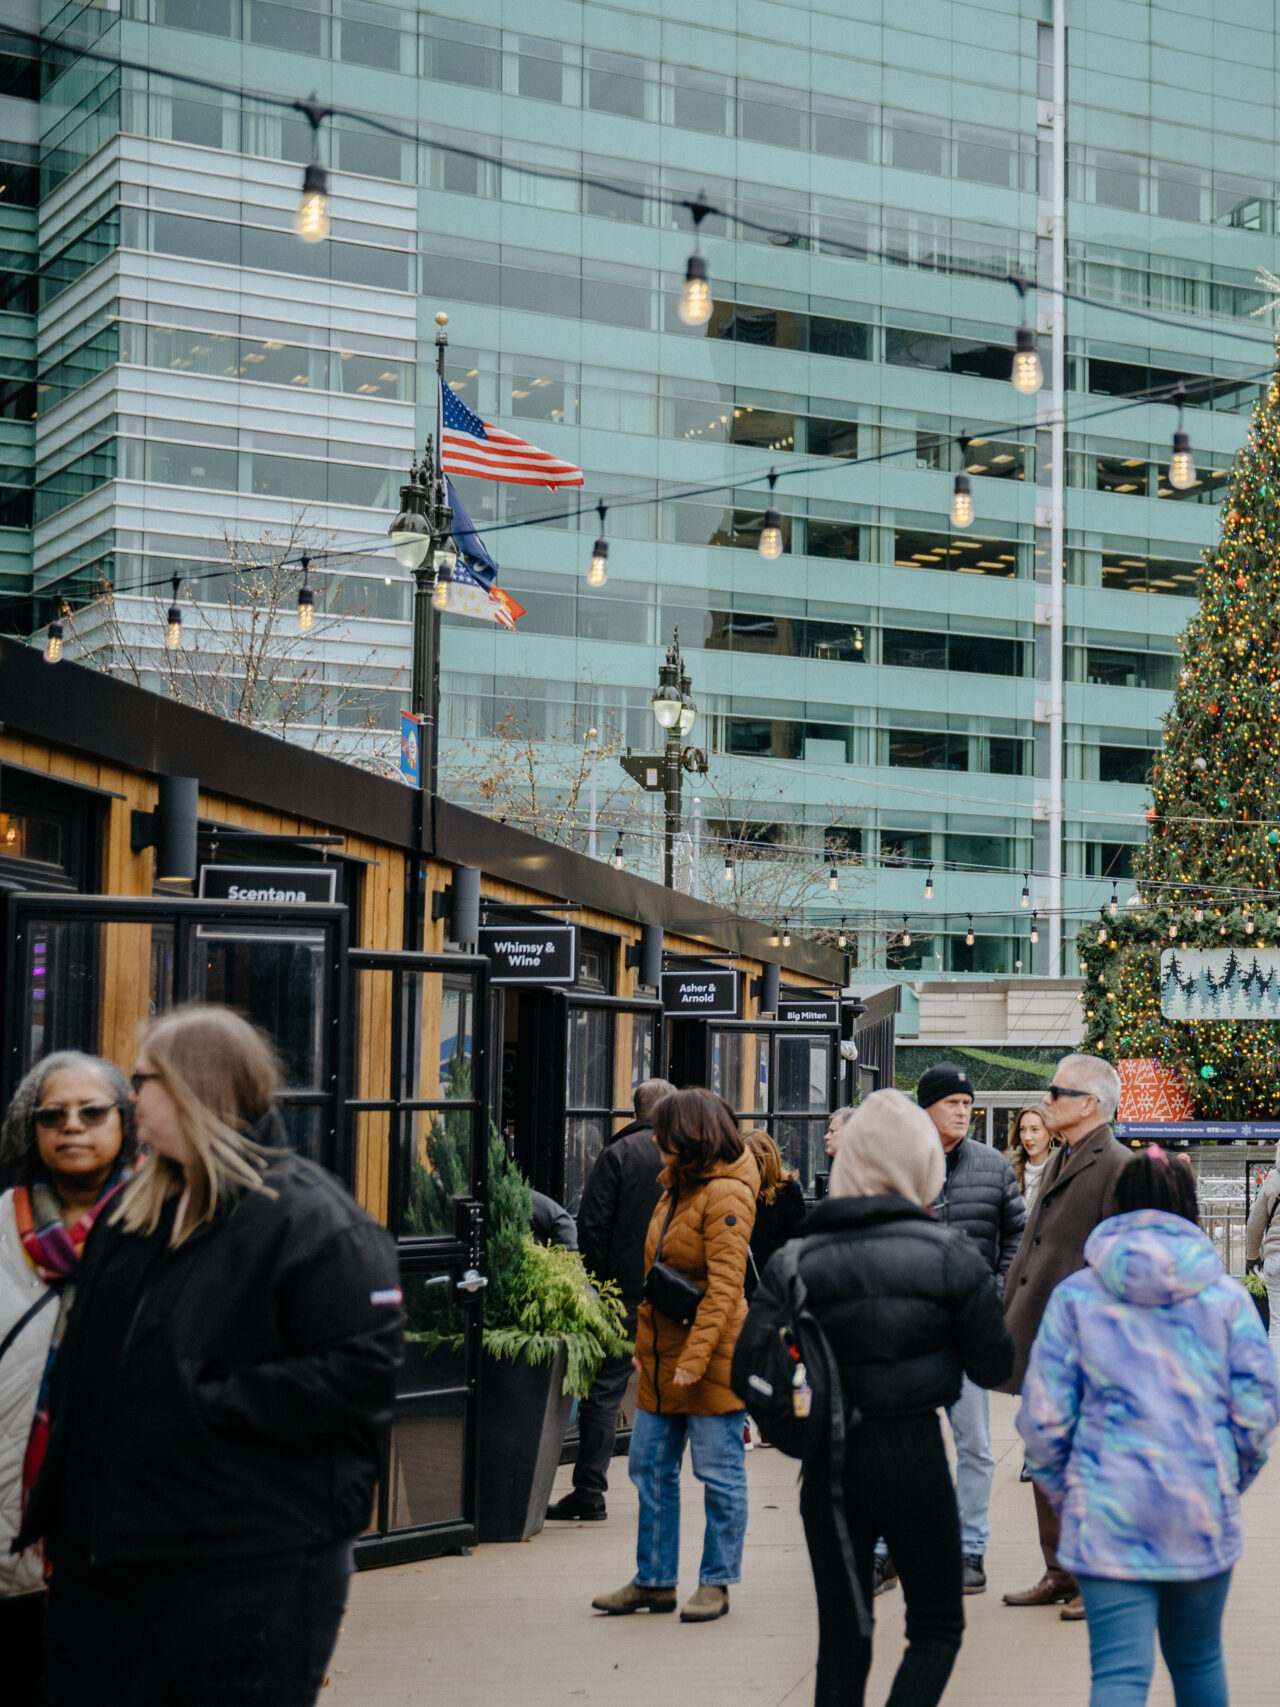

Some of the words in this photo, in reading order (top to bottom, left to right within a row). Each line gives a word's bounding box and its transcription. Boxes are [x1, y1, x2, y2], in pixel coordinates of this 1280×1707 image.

[227, 885, 307, 902] Scentana
[494, 942, 544, 956] Whimsy
[545, 941, 556, 954] &
[508, 955, 541, 967] Wine
[679, 983, 707, 993] Asher
[708, 983, 717, 993] &
[681, 993, 715, 1003] Arnold
[787, 1011, 800, 1021] Big
[801, 1011, 828, 1020] Mitten
